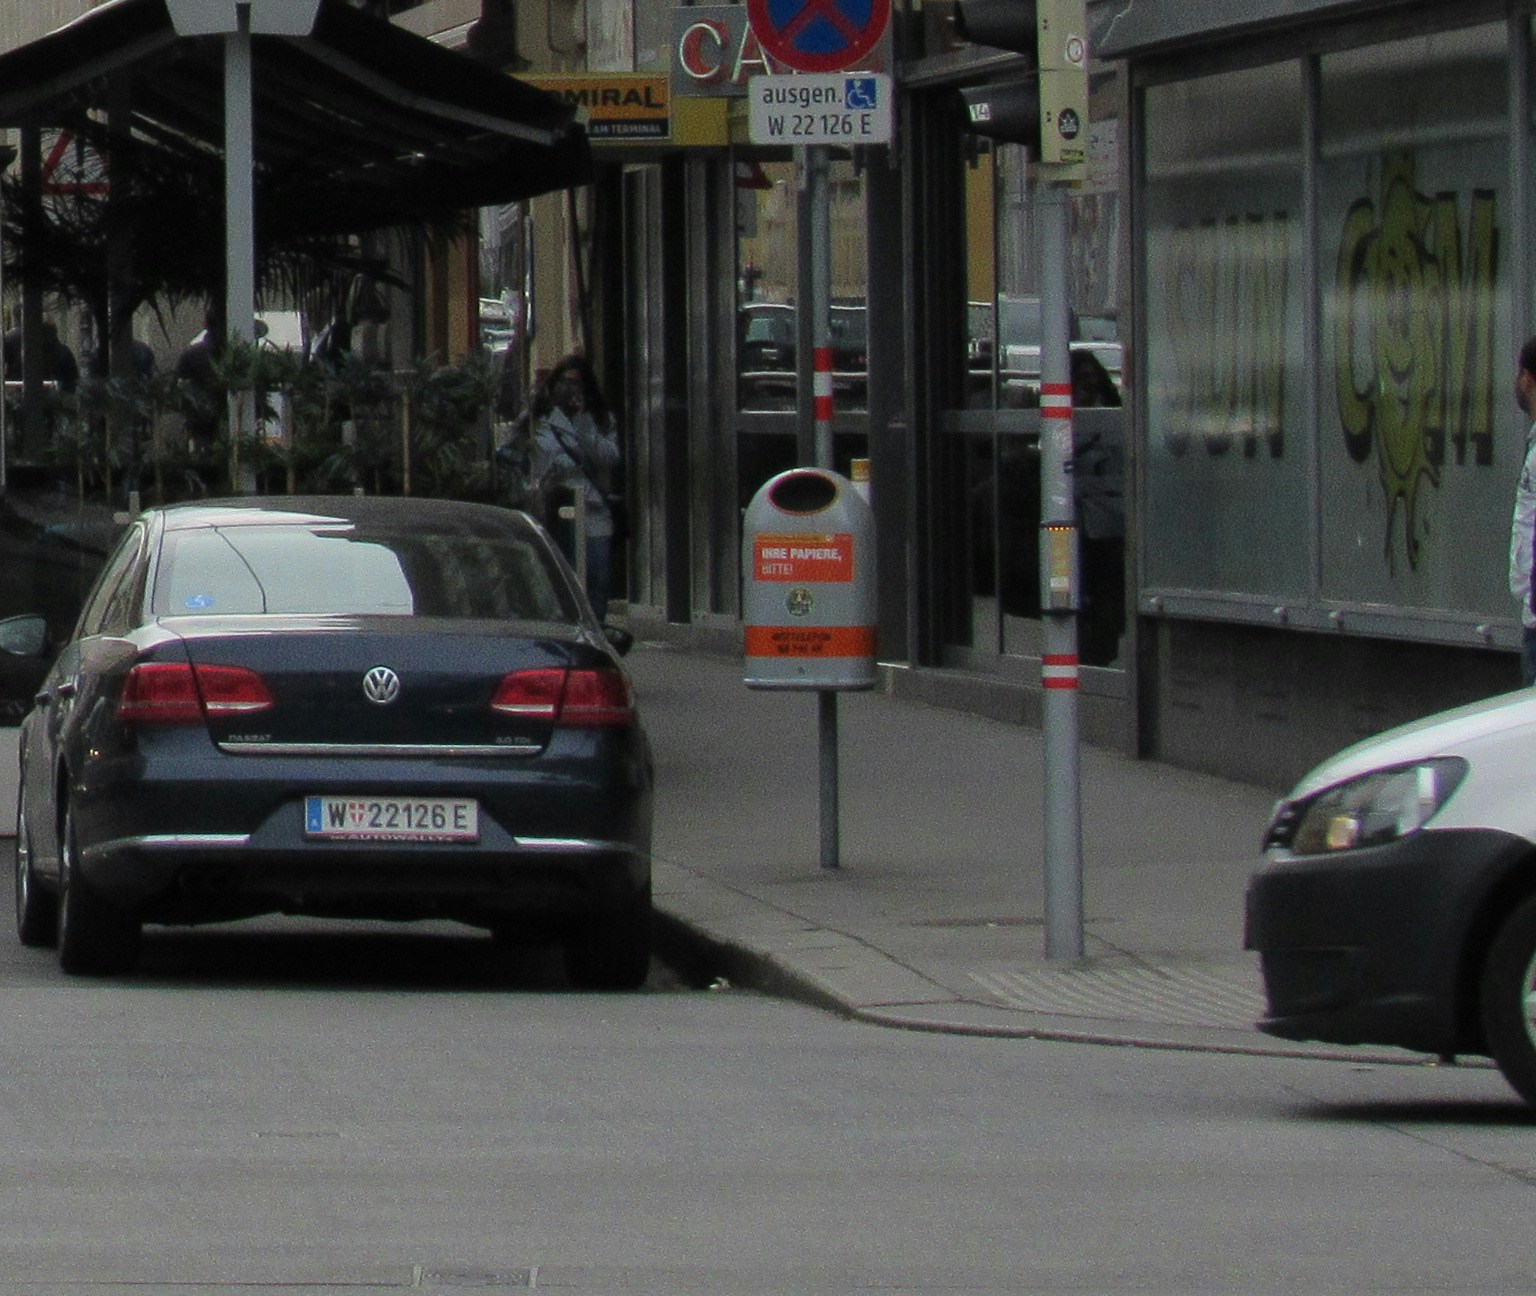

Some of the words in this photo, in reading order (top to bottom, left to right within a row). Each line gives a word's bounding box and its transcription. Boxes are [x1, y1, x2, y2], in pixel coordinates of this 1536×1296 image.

[762, 87, 842, 108] ausgen.
[768, 115, 785, 136] W
[861, 114, 872, 135] E
[328, 803, 347, 828] W
[368, 803, 447, 829] 22126
[453, 804, 468, 829] E
